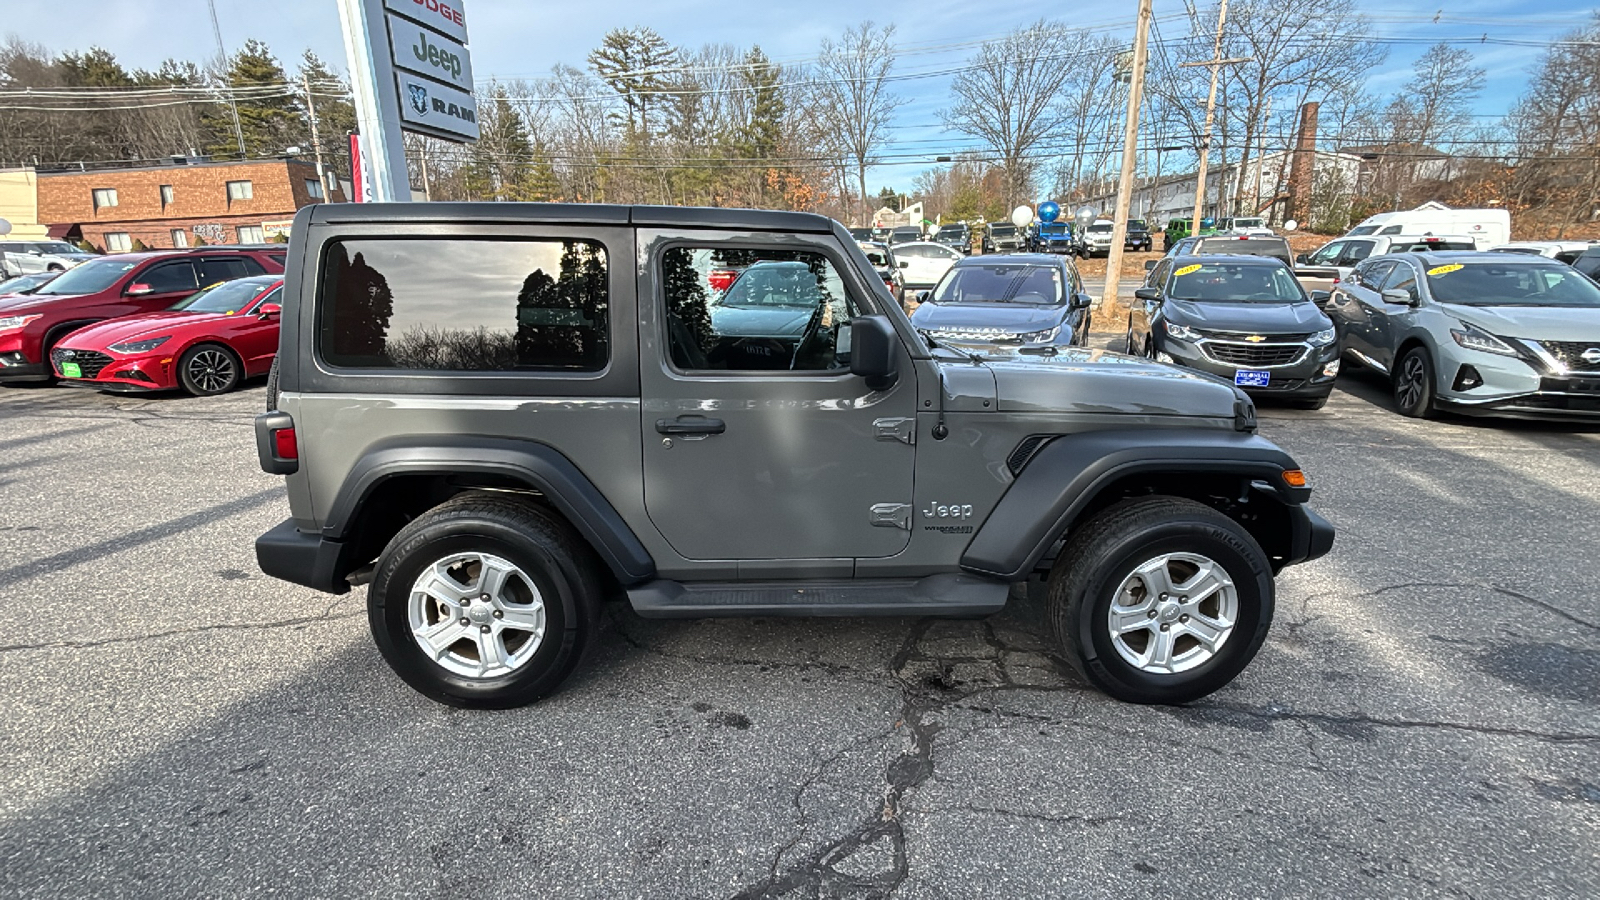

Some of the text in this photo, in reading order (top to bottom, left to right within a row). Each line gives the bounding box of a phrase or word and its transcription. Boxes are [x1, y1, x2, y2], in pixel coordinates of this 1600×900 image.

[413, 0, 463, 27] ODGE
[413, 32, 461, 80] Jeep
[431, 97, 475, 123] RAM
[923, 501, 973, 520] Jeep
